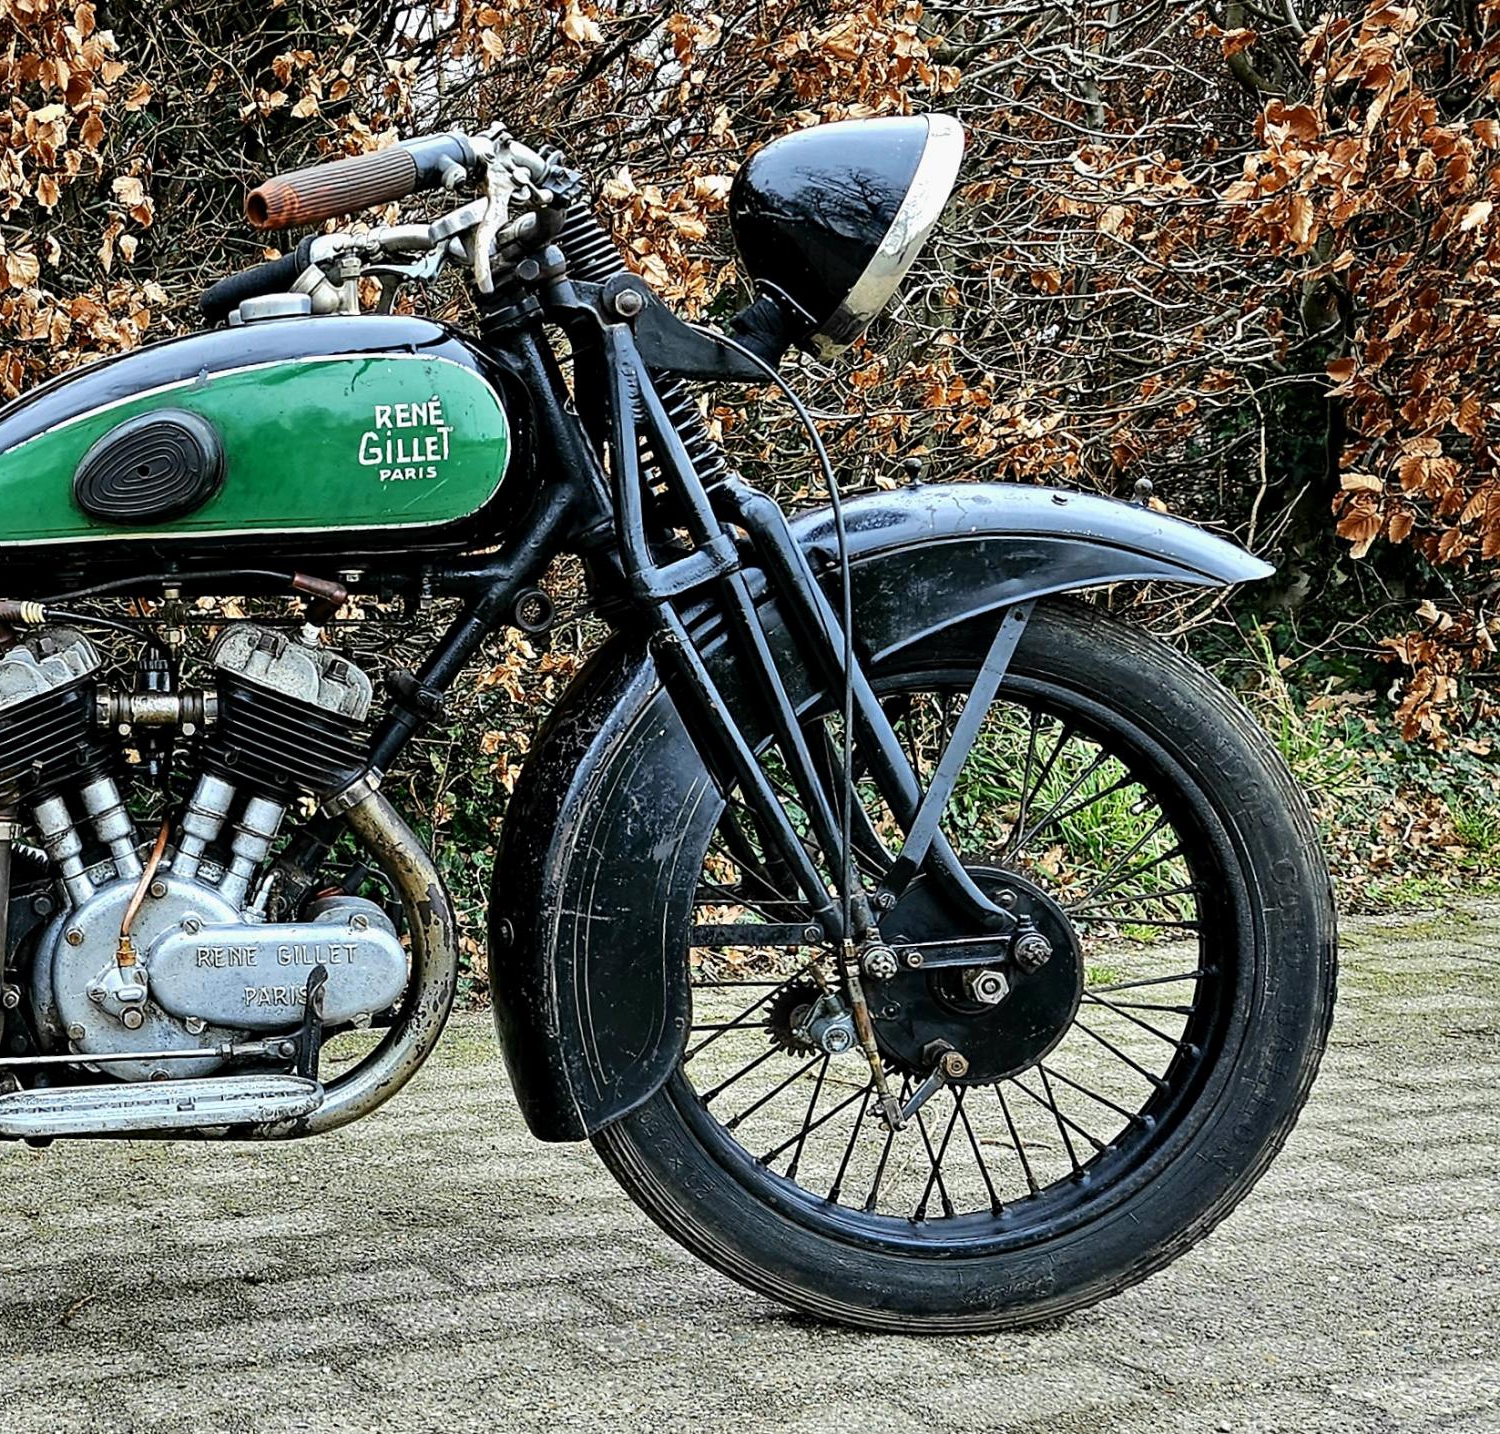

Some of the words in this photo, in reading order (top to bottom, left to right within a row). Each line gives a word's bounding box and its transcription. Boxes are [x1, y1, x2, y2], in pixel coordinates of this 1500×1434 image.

[375, 395, 444, 429] RENÉ
[380, 466, 437, 481] PARIS
[276, 943, 358, 966] GILLET
[244, 985, 309, 1007] PARIS
